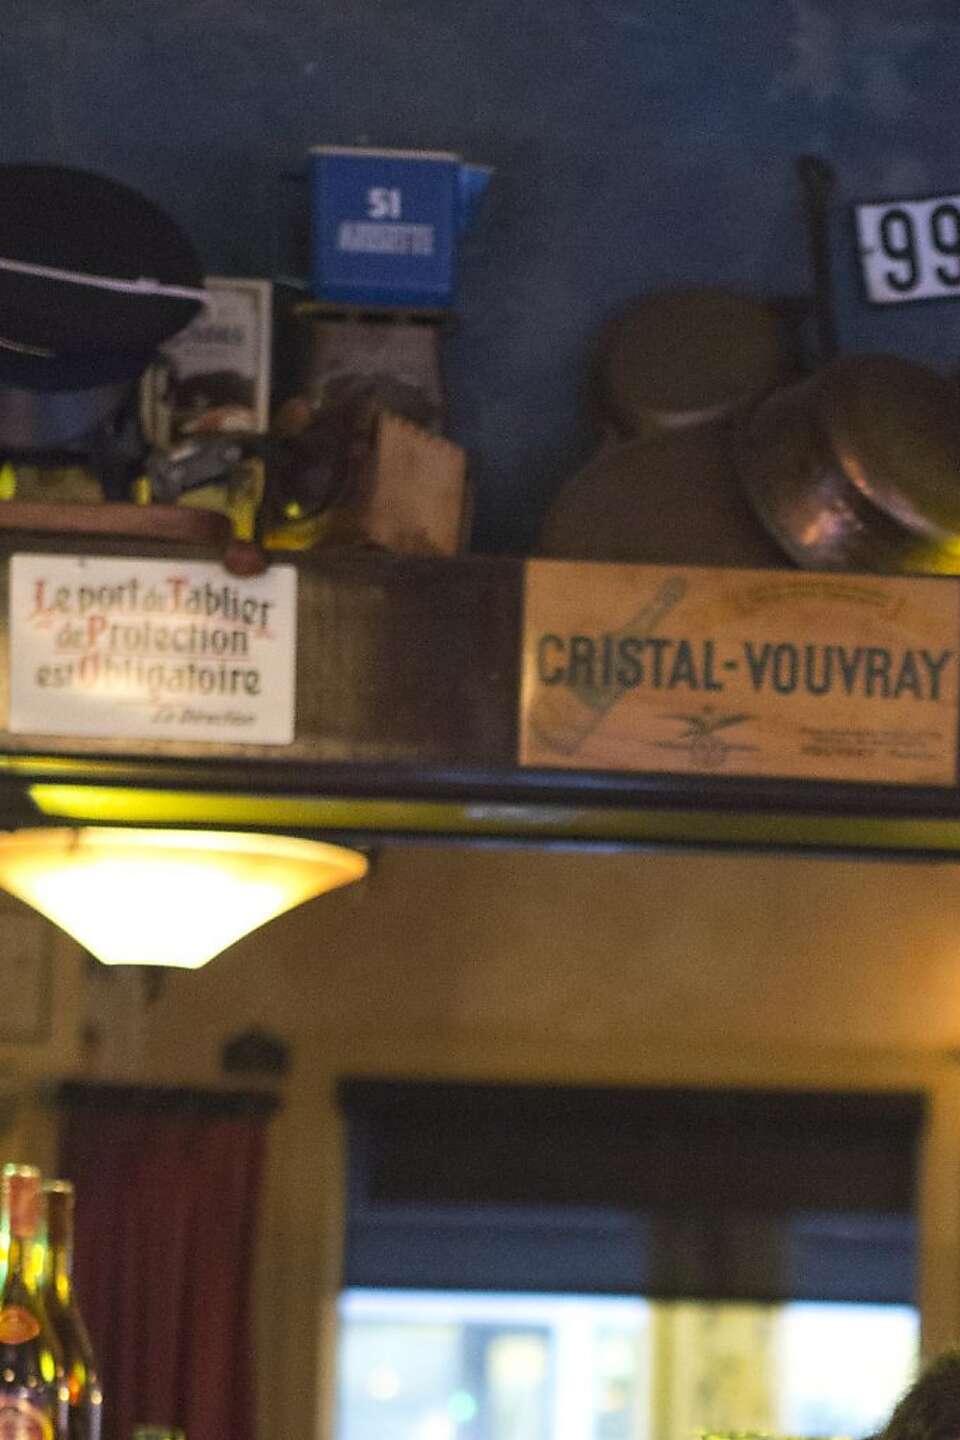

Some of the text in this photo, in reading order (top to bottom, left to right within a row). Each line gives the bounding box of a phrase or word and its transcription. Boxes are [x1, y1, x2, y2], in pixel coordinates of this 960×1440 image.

[78, 577, 139, 615] port
[167, 574, 273, 631] Tablier
[84, 614, 250, 656] Protection
[537, 633, 950, 701] CRISTAL-VOUVRAY
